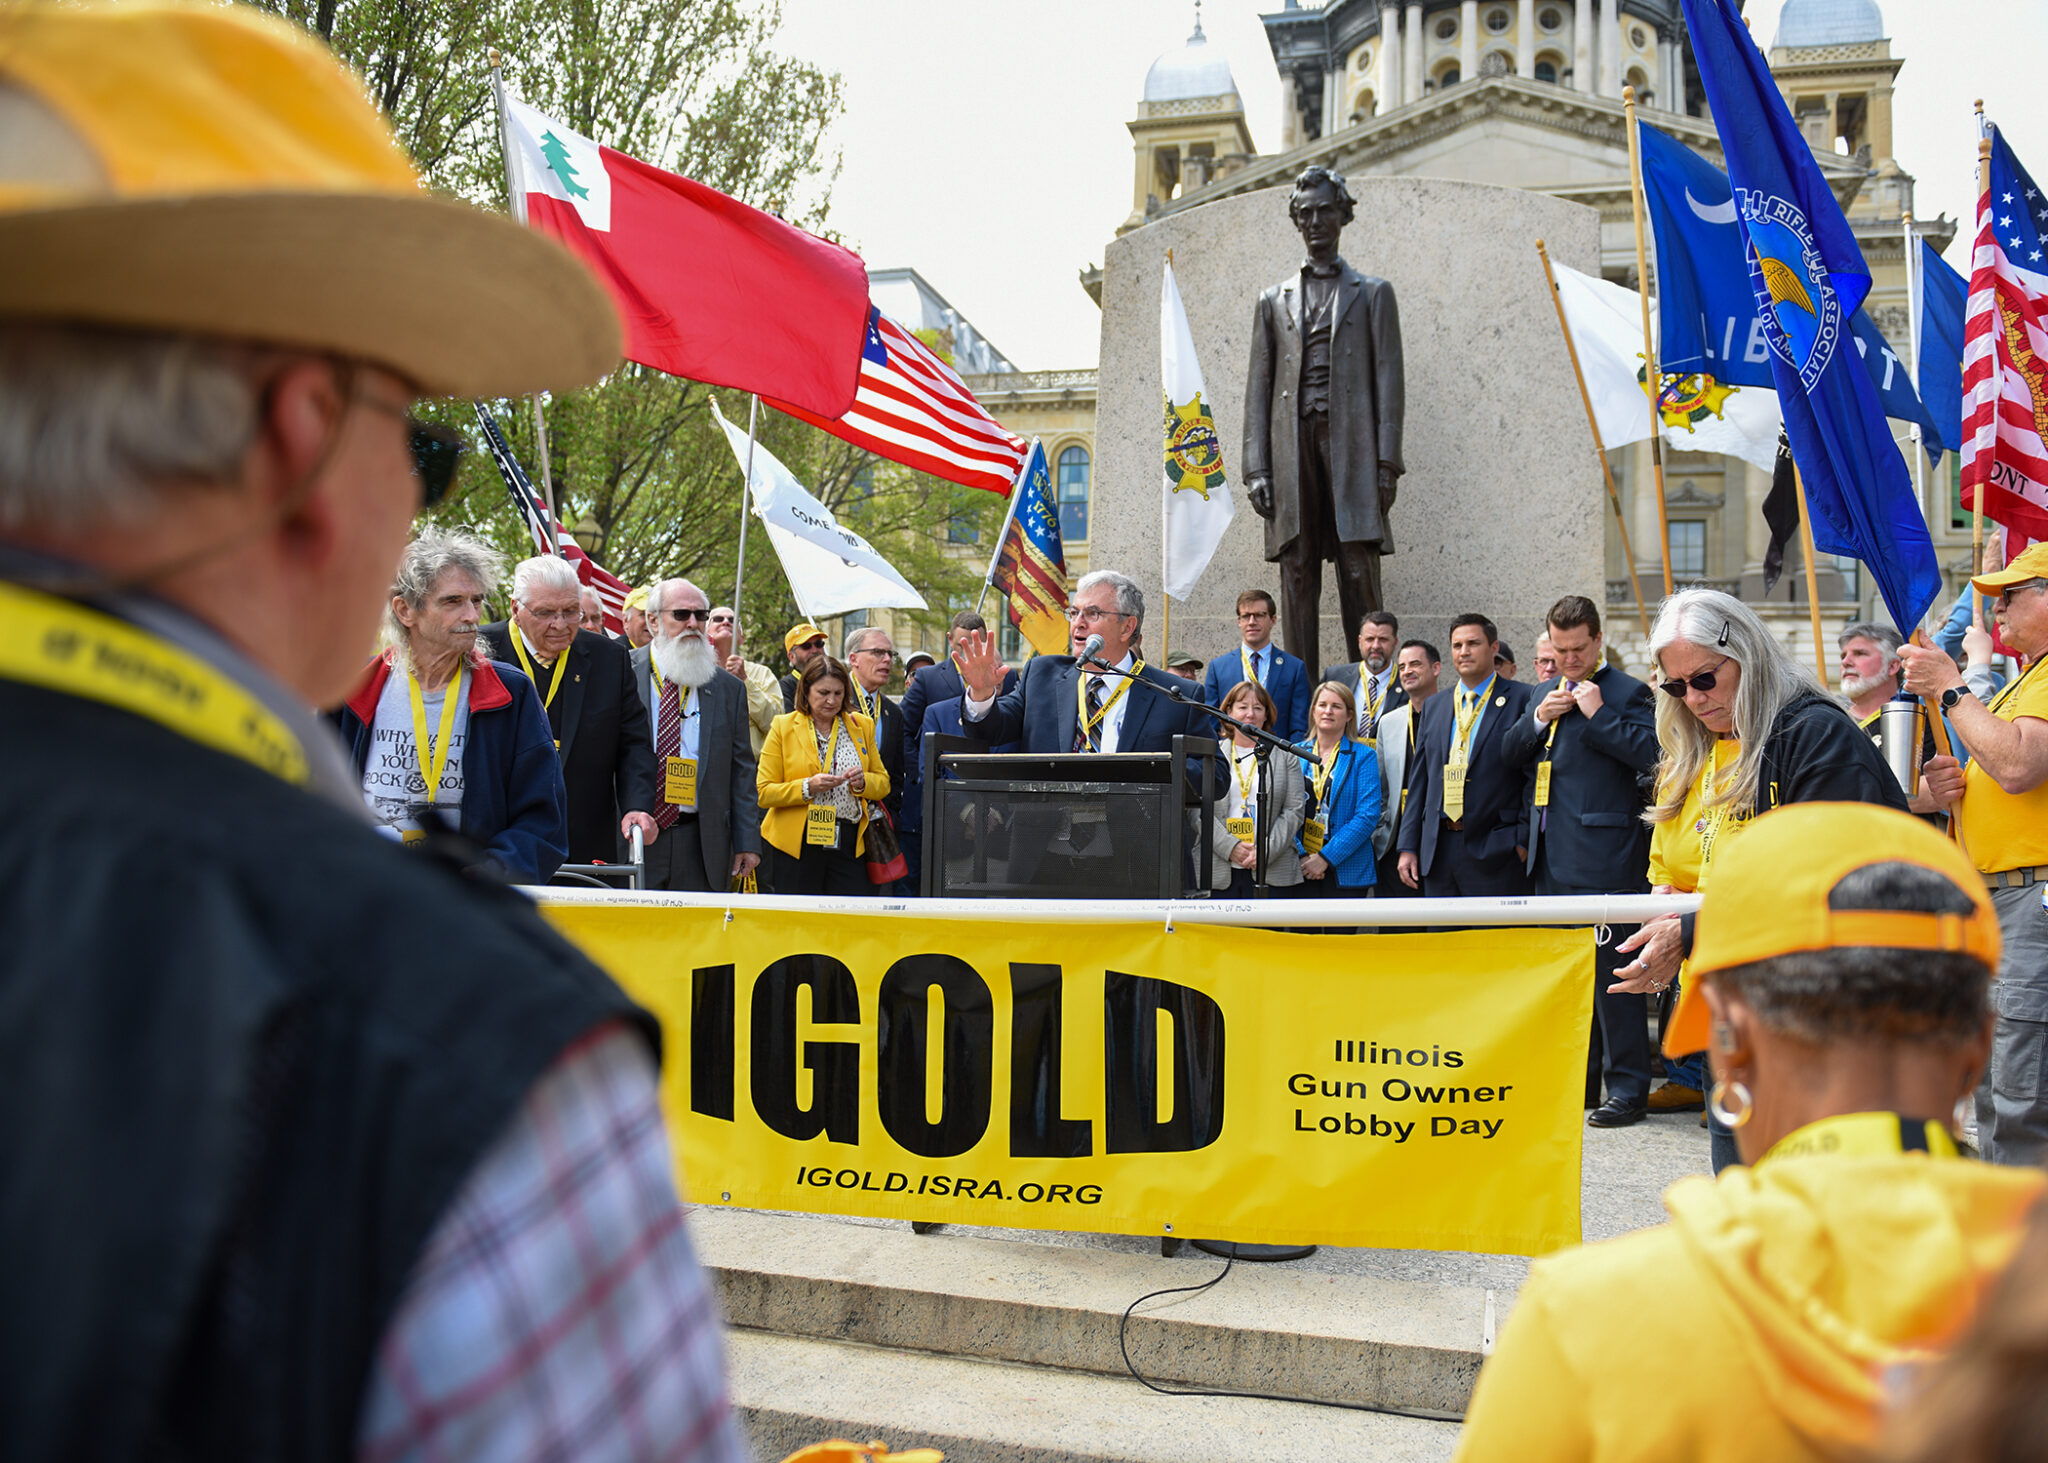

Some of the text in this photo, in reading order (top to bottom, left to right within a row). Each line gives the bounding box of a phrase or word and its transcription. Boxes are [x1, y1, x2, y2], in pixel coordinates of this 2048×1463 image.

[1774, 203, 1813, 245] RIFLE
[1762, 312, 1777, 330] OF
[1801, 285, 1836, 388] ASSOCIATI
[792, 506, 830, 530] COME
[1033, 500, 1057, 527] 1776
[376, 729, 412, 744] WHY
[381, 755, 414, 770] YOU
[668, 762, 695, 778] IGOLD
[365, 772, 402, 787] ROCK
[809, 809, 835, 823] IGOLD
[1228, 821, 1252, 835] IGOLD
[690, 953, 1226, 1158] IGOLD
[1335, 1039, 1464, 1068] Illinois
[1287, 1073, 1513, 1103] Gun Owner
[1294, 1109, 1504, 1143] Lobby Day
[796, 1166, 1104, 1205] IGOLD.ISRA.ORG
